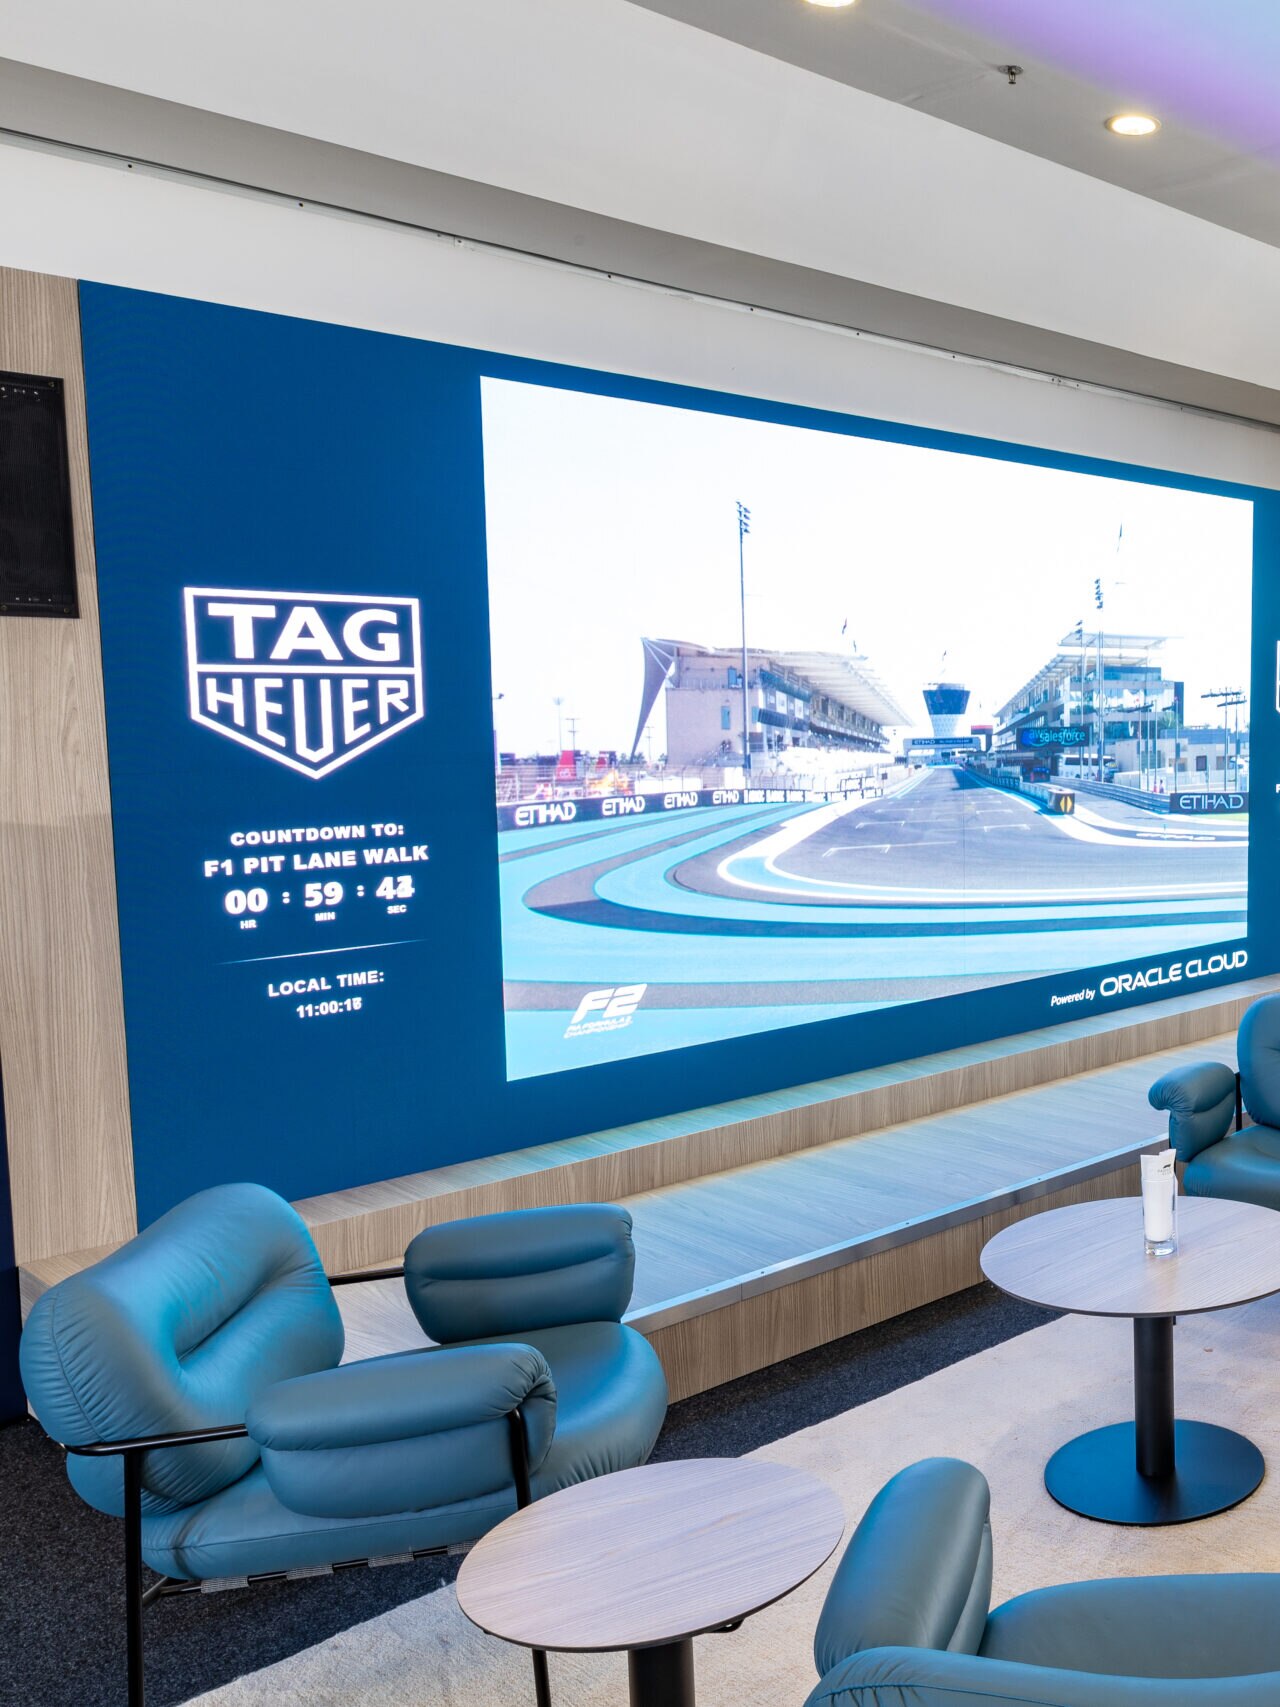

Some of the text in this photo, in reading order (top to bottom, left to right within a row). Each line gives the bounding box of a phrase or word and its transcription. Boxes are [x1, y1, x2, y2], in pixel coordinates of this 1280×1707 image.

[208, 603, 400, 662] TAG
[206, 678, 409, 762] HEUER
[1040, 728, 1086, 744] salesforce
[602, 796, 646, 816] ETIHAD
[664, 792, 698, 810] ETIHAD
[713, 790, 740, 804] ETIHAD
[1179, 794, 1244, 810] ETIHAD
[515, 802, 577, 826] ETIHAD
[230, 823, 404, 846] COUNTDOWN TO:
[204, 845, 429, 877] F1 PIT LANE WALK
[225, 888, 268, 914] 00
[304, 881, 344, 907] 59
[315, 912, 336, 921] MIN
[387, 905, 407, 914] SEC
[240, 920, 257, 929] HR
[268, 970, 384, 997] LOCAL TIME:
[1050, 950, 1248, 1006] Powered by ORACLE CLOUD
[571, 983, 647, 1025] F2
